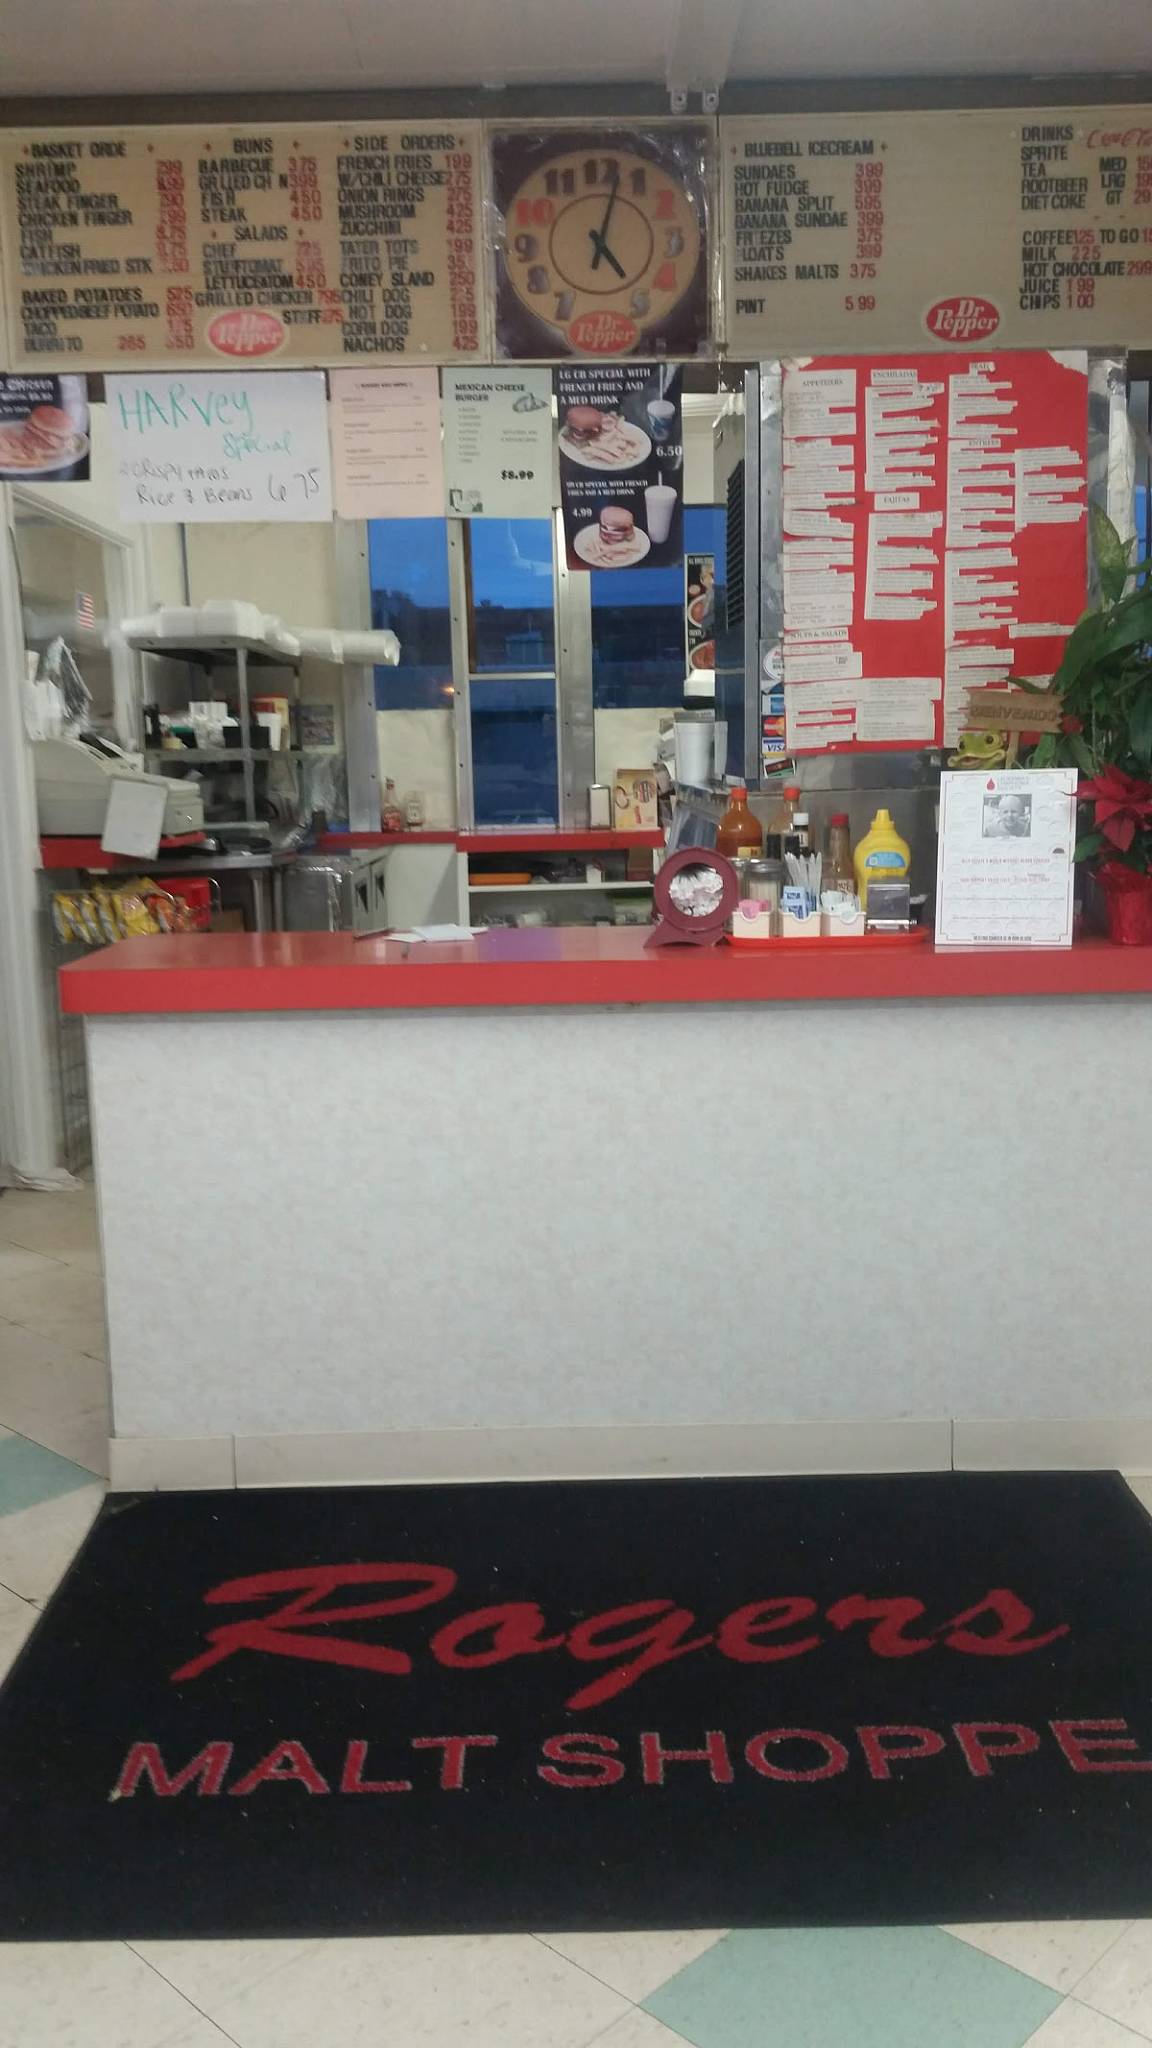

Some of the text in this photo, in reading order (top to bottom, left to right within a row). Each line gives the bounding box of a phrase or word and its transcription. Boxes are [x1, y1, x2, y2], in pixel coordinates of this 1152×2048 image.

[1021, 126, 1073, 142] DRINKS
[31, 141, 83, 158] BASKET
[233, 138, 274, 155] BUNS
[354, 134, 455, 152] SIDE ORDERS
[744, 140, 874, 157] BLUEBELL ICECREAM
[1021, 146, 1068, 161] SPRITE
[15, 161, 77, 180] SHRIMP
[198, 157, 274, 174] BARBECUE
[337, 155, 390, 171] FRENCH
[393, 155, 432, 170] FRIES
[584, 158, 620, 184] 12
[1021, 163, 1046, 177] TEA
[1100, 156, 1127, 172] MED
[396, 171, 446, 186] CHEESE
[632, 167, 645, 194] 1
[734, 164, 796, 180] SUNDAES
[546, 168, 575, 194] 11
[734, 181, 759, 196] HOT
[766, 180, 809, 195] FUDGE
[1021, 178, 1088, 193] ROOTBEER
[17, 193, 119, 210] STEAK FINGER
[201, 191, 236, 207] FISH
[338, 187, 425, 204] ONION RINGS
[1021, 194, 1086, 210] DIET COKE
[338, 203, 416, 219] MUSHROOM
[515, 198, 555, 226] 10
[656, 190, 674, 220] 2
[734, 196, 835, 213] BANANA SPLIT
[17, 210, 133, 227] CHICKEN FINGER
[201, 208, 247, 223] STEAK
[735, 214, 787, 230] BANANA
[795, 212, 848, 227] SUNDAE
[234, 225, 288, 242] SALADS
[340, 220, 402, 236] ZUCCHINI
[1022, 229, 1073, 245] COFFEE
[1100, 229, 1115, 244] TO
[1119, 228, 1139, 243] GO
[385, 239, 419, 254] TOTS
[514, 233, 537, 263] 9
[665, 226, 684, 258] 3
[20, 244, 81, 260] CATFISH
[203, 243, 237, 259] CHEF
[1022, 247, 1056, 262] MILK
[125, 258, 153, 274] STK
[341, 255, 410, 270] FRITO PIE
[1023, 260, 1126, 278] HOT CHOCOLATE
[340, 272, 384, 287] CONEY
[527, 265, 546, 294] 8
[653, 263, 676, 290] 4
[735, 265, 787, 281] SHAKES
[795, 264, 839, 279] MALTS
[1020, 278, 1060, 294] JUICE
[21, 287, 143, 304] BAKED POTATOES
[195, 290, 313, 307] GRILLED CHICKEN
[382, 289, 410, 303] DOG
[629, 288, 650, 320] 5
[1019, 294, 1061, 310] CHIPS
[349, 305, 377, 320] HOT
[385, 304, 413, 319] DOG
[555, 289, 576, 321] 7
[735, 299, 766, 314] PINT
[957, 299, 984, 318] Dr
[341, 322, 377, 337] CORN
[382, 320, 410, 336] DOG
[596, 314, 620, 331] Dr
[934, 309, 999, 338] Pepper
[576, 323, 635, 348] Pepper
[343, 336, 405, 353] NACHOS
[588, 368, 625, 379] SPECIAL
[627, 367, 650, 378] WITH
[455, 383, 525, 392] MEXICAN CHEESE
[560, 382, 644, 392] FRENCH FRIES AND
[455, 393, 489, 402] BURGER
[560, 395, 619, 405] A MED DRINK
[656, 445, 683, 457] 6.50
[501, 470, 534, 480] $8.99
[572, 507, 592, 517] 4.99
[768, 744, 786, 753] VIS
[170, 1562, 1070, 1710] Rogers
[112, 1719, 1152, 1797] MALT SHOPPE
